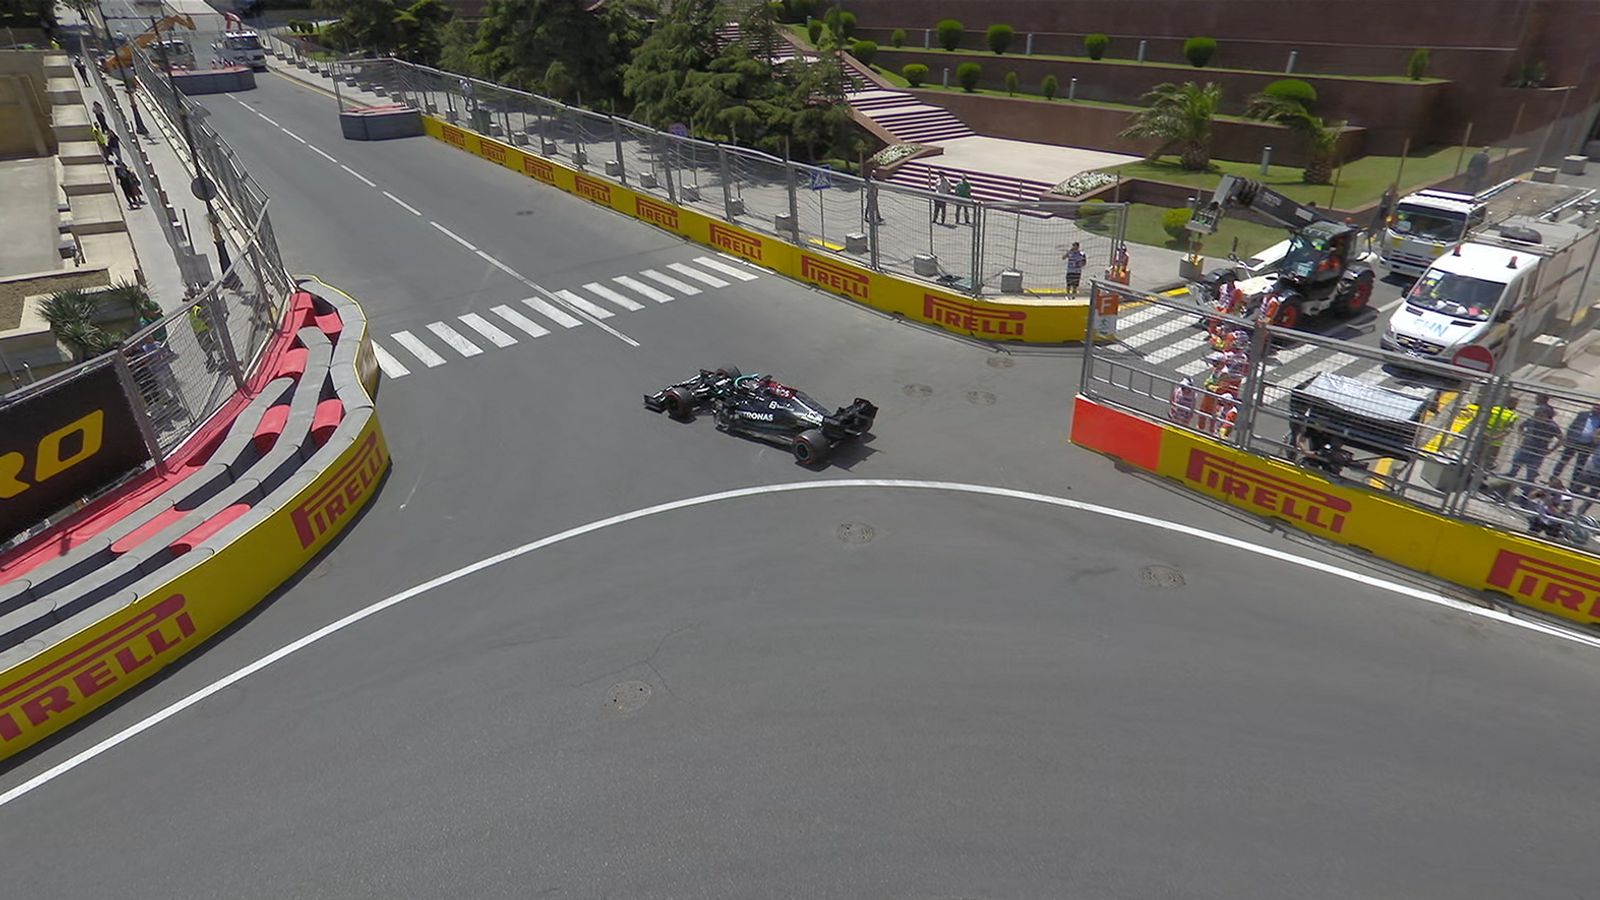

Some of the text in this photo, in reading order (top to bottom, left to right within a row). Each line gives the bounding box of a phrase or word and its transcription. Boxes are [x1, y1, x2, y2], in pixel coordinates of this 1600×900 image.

[524, 156, 554, 182] PIRELLI
[575, 175, 611, 204] PIRELLI
[635, 197, 679, 229] PIRELLI
[709, 223, 762, 260] PIRELLI
[801, 255, 870, 299] PIRELLI
[923, 293, 1027, 336] PIRELLI
[291, 431, 383, 549] PIRELLI
[1186, 447, 1352, 533] PIRELLI
